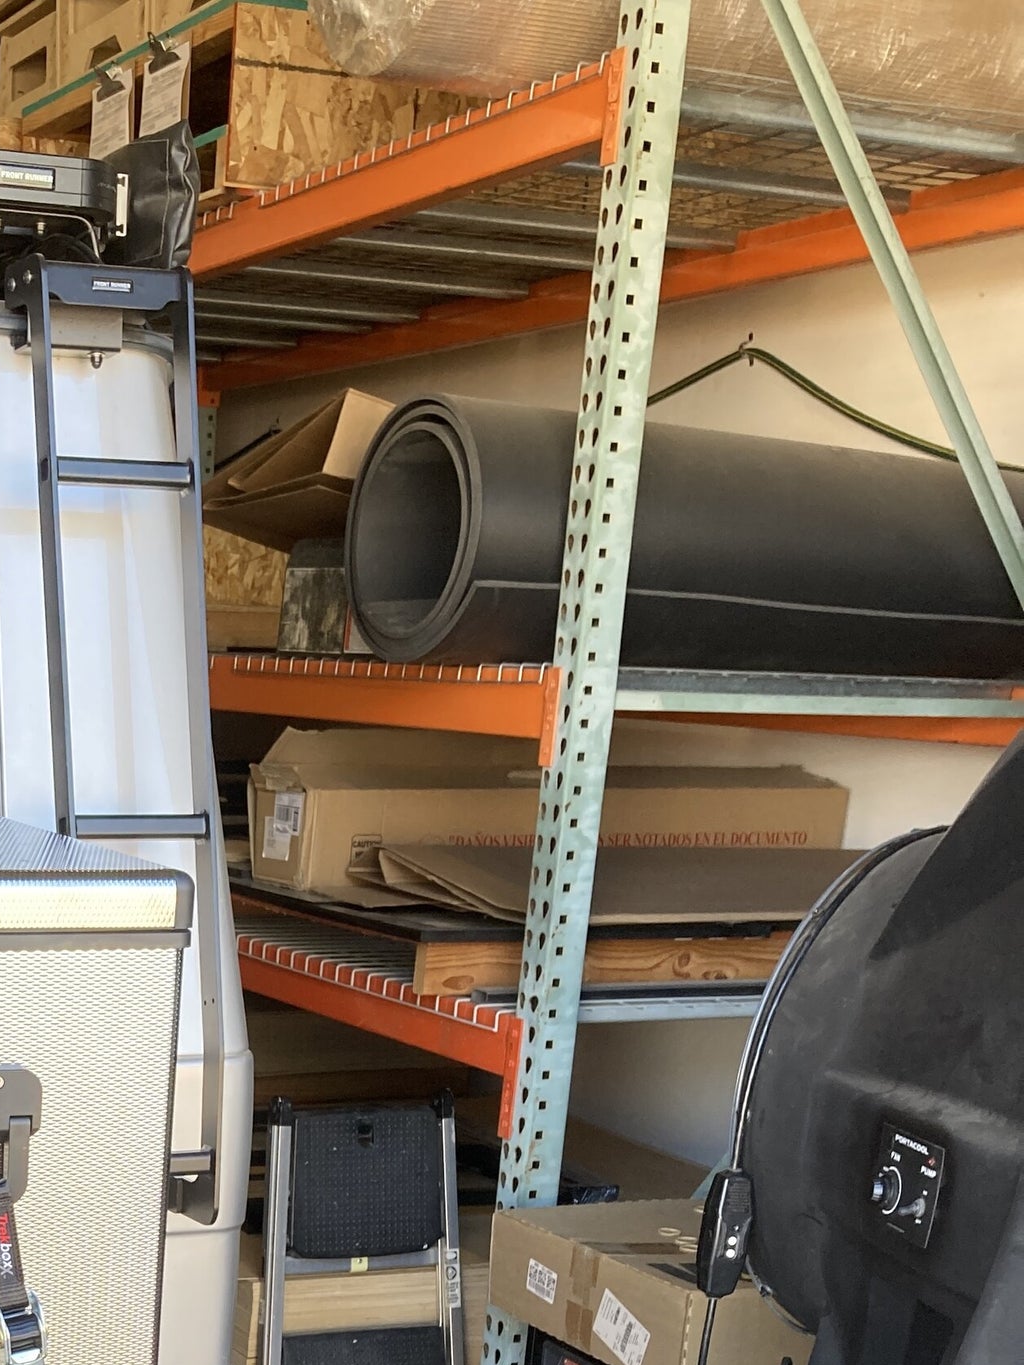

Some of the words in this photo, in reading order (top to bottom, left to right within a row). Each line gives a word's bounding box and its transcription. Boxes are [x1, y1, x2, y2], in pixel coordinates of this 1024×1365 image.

[730, 831, 808, 846] DOCUMENTO
[895, 1133, 929, 1155] PORTACOOL
[920, 1165, 937, 1178] PUMP
